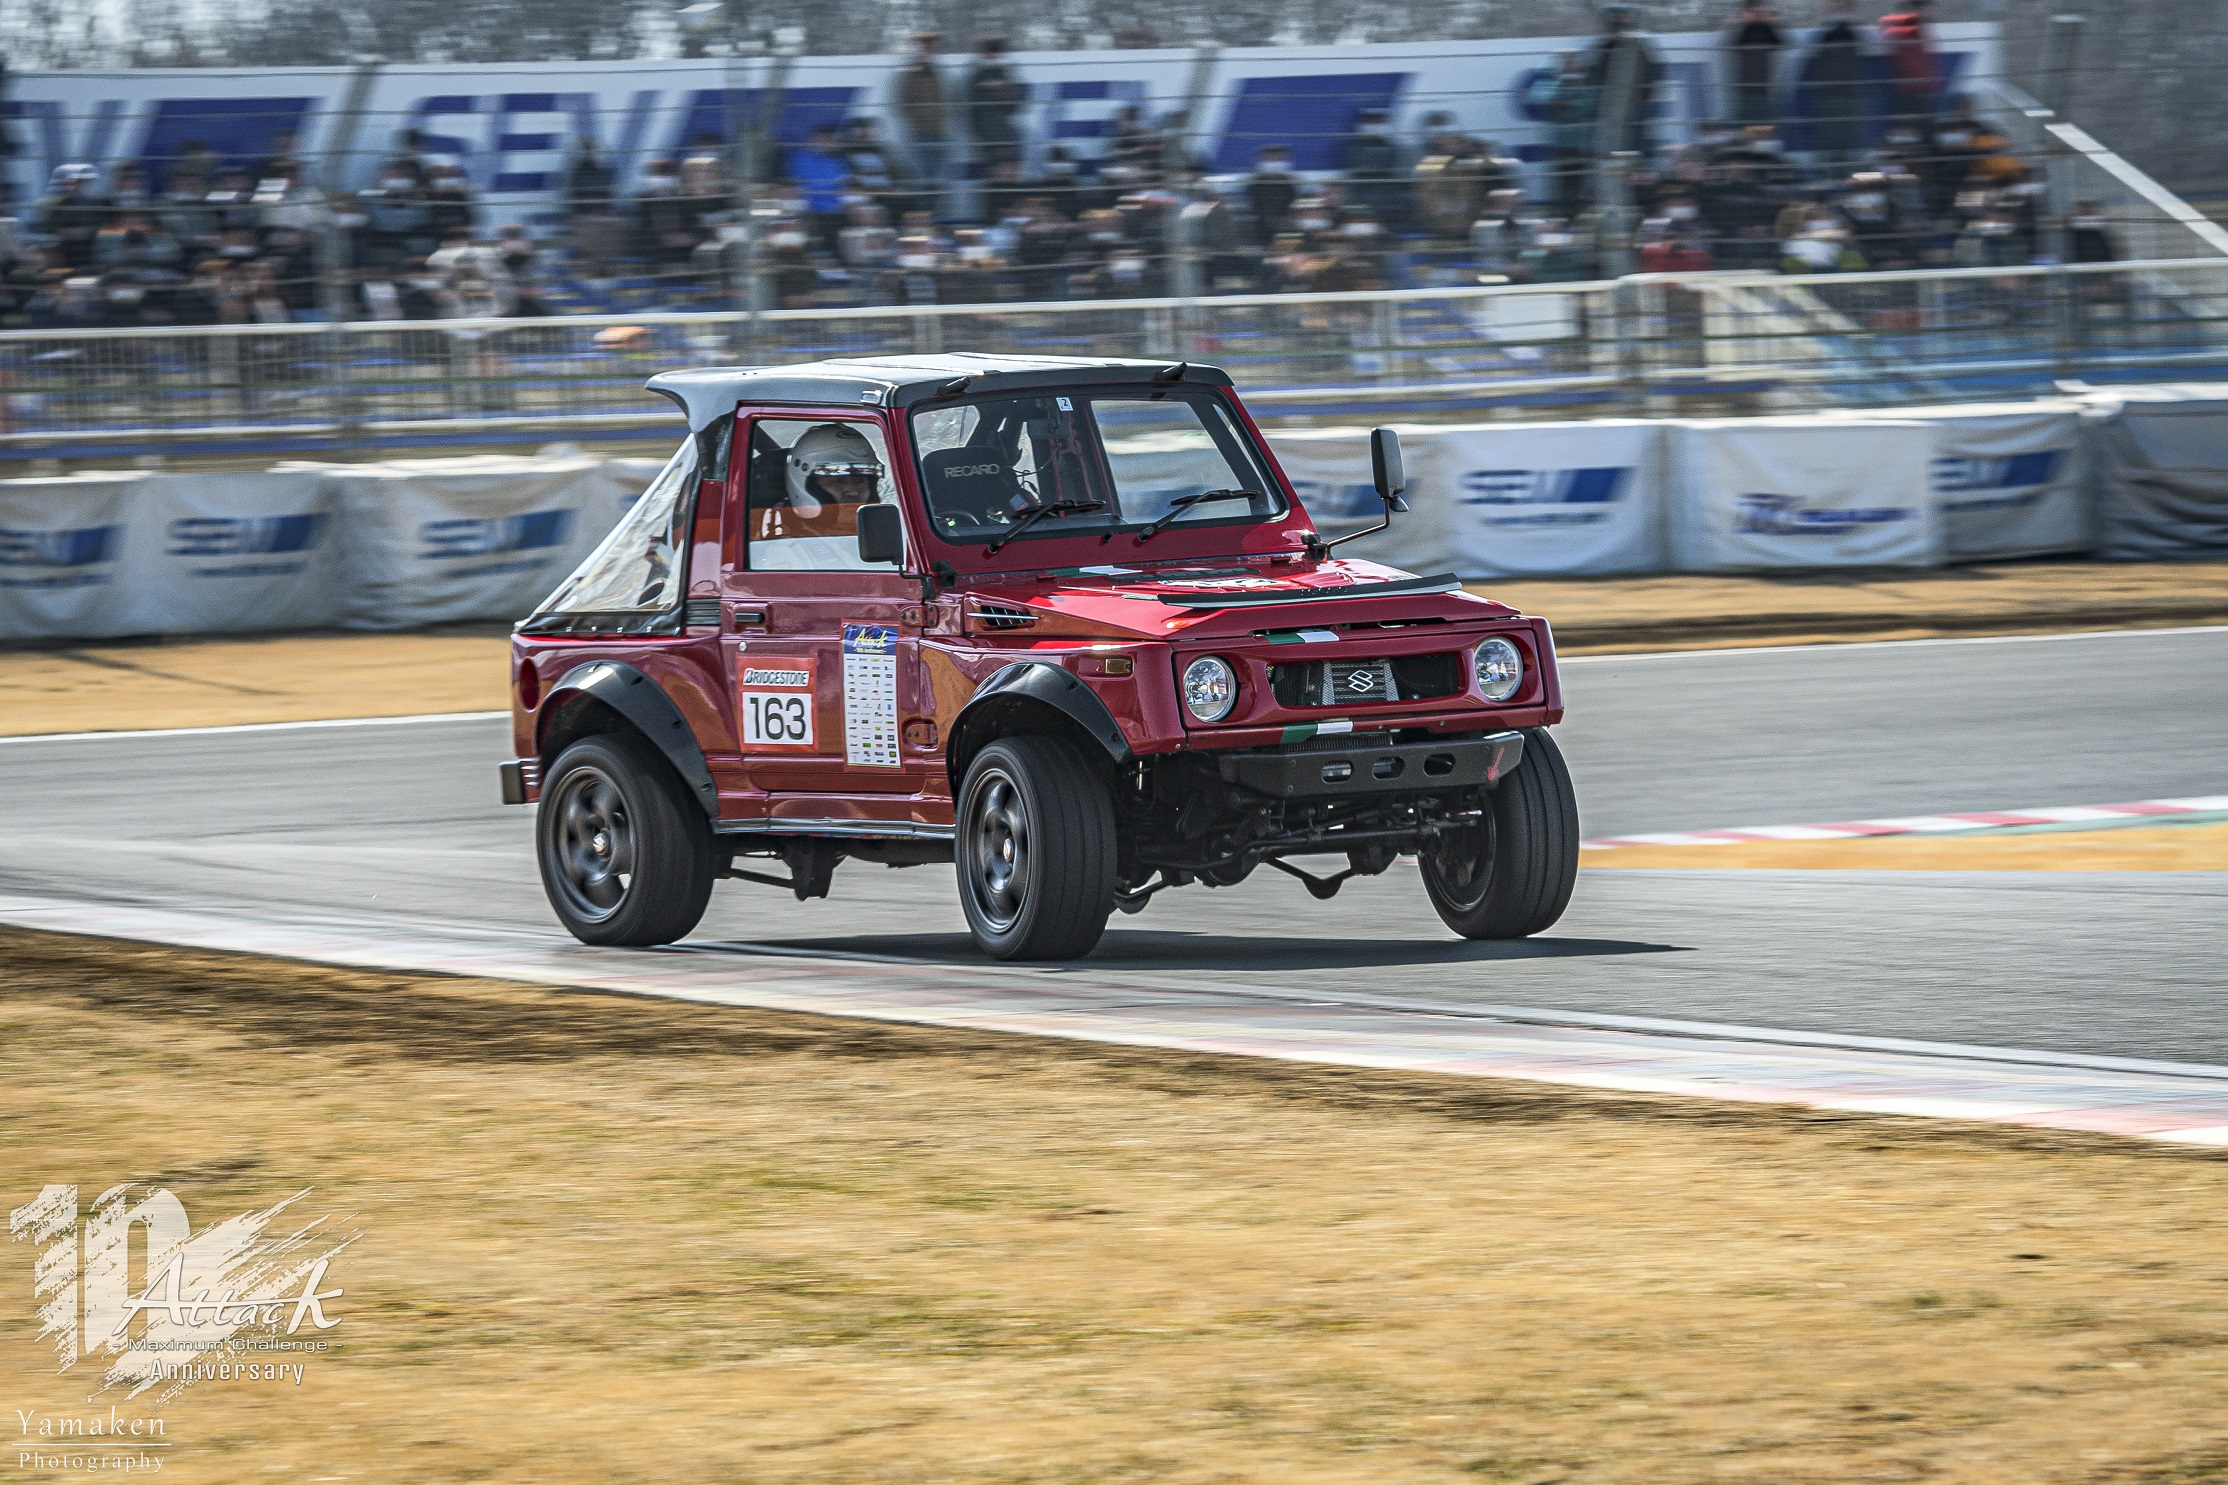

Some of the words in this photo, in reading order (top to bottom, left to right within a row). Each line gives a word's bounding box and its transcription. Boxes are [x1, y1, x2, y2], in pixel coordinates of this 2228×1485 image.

[944, 463, 1000, 478] RECARO
[744, 669, 808, 684] BRIDGESTONE
[749, 697, 806, 740] 163
